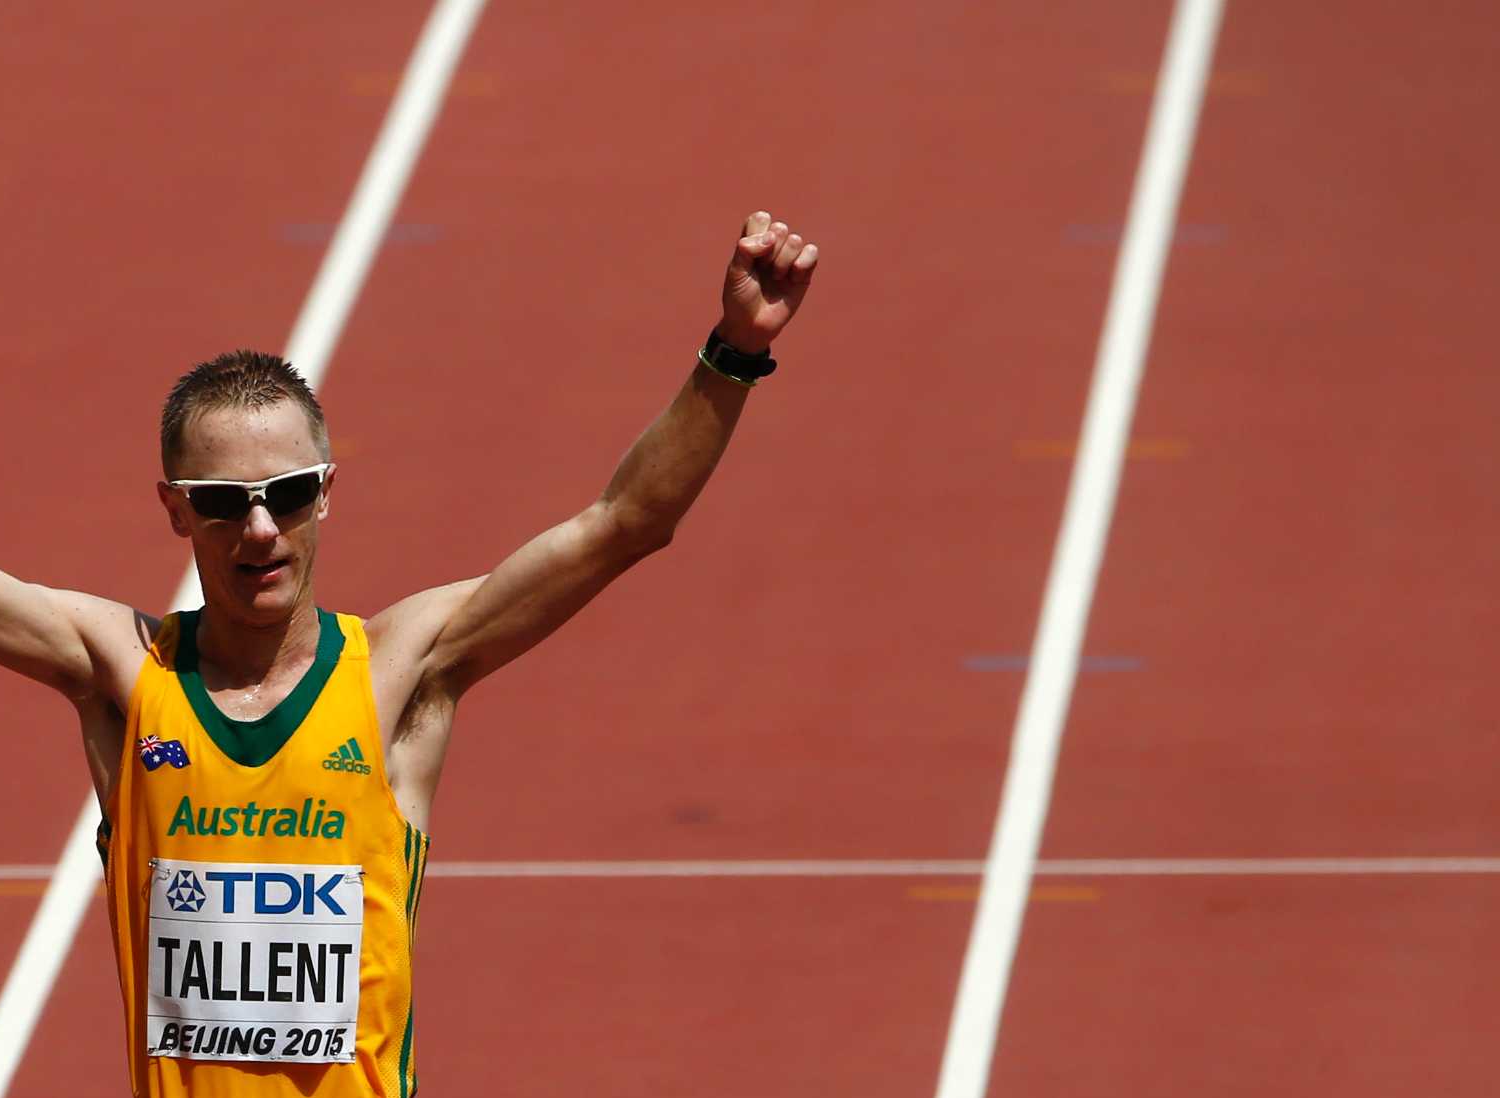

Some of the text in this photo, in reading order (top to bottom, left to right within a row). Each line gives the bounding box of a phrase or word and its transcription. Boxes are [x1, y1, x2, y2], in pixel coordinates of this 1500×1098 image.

[322, 757, 371, 775] adidas
[167, 796, 345, 839] Australia
[206, 873, 346, 915] TDK
[158, 937, 352, 1003] TALLENT
[159, 1023, 346, 1056] BEIJING 2015
